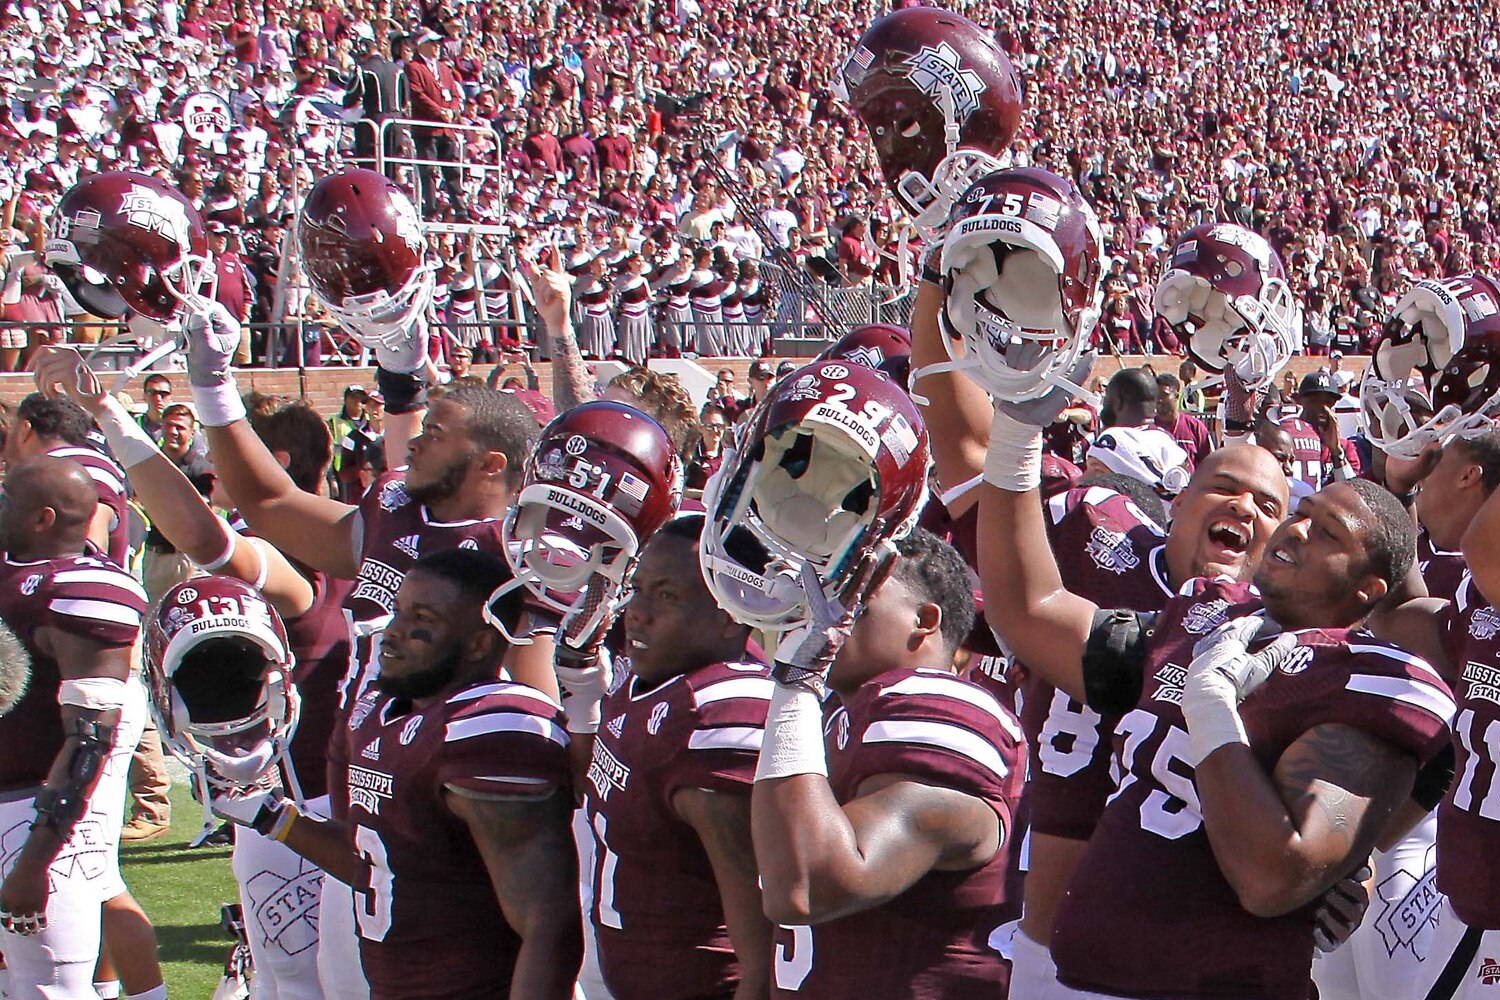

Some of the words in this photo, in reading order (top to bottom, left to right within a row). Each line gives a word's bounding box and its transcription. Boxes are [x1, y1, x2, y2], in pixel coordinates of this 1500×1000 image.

[928, 60, 967, 103] STATE
[968, 188, 984, 203] SEC
[978, 193, 1024, 216] 75
[961, 219, 1022, 234] BULLDOGS
[822, 366, 849, 379] SEC
[825, 382, 892, 428] 29
[817, 406, 876, 447] BULLDOGS
[567, 437, 587, 454] SEC
[569, 458, 612, 502] 51
[546, 489, 607, 525] BULLDOGS
[1095, 550, 1115, 568] 100
[179, 589, 198, 603] SEC
[198, 596, 239, 619] 13
[192, 616, 250, 633] BULLDOGS
[1279, 646, 1315, 676] SEC
[349, 768, 393, 795] ISSISSIPPI
[1105, 708, 1203, 840] 75
